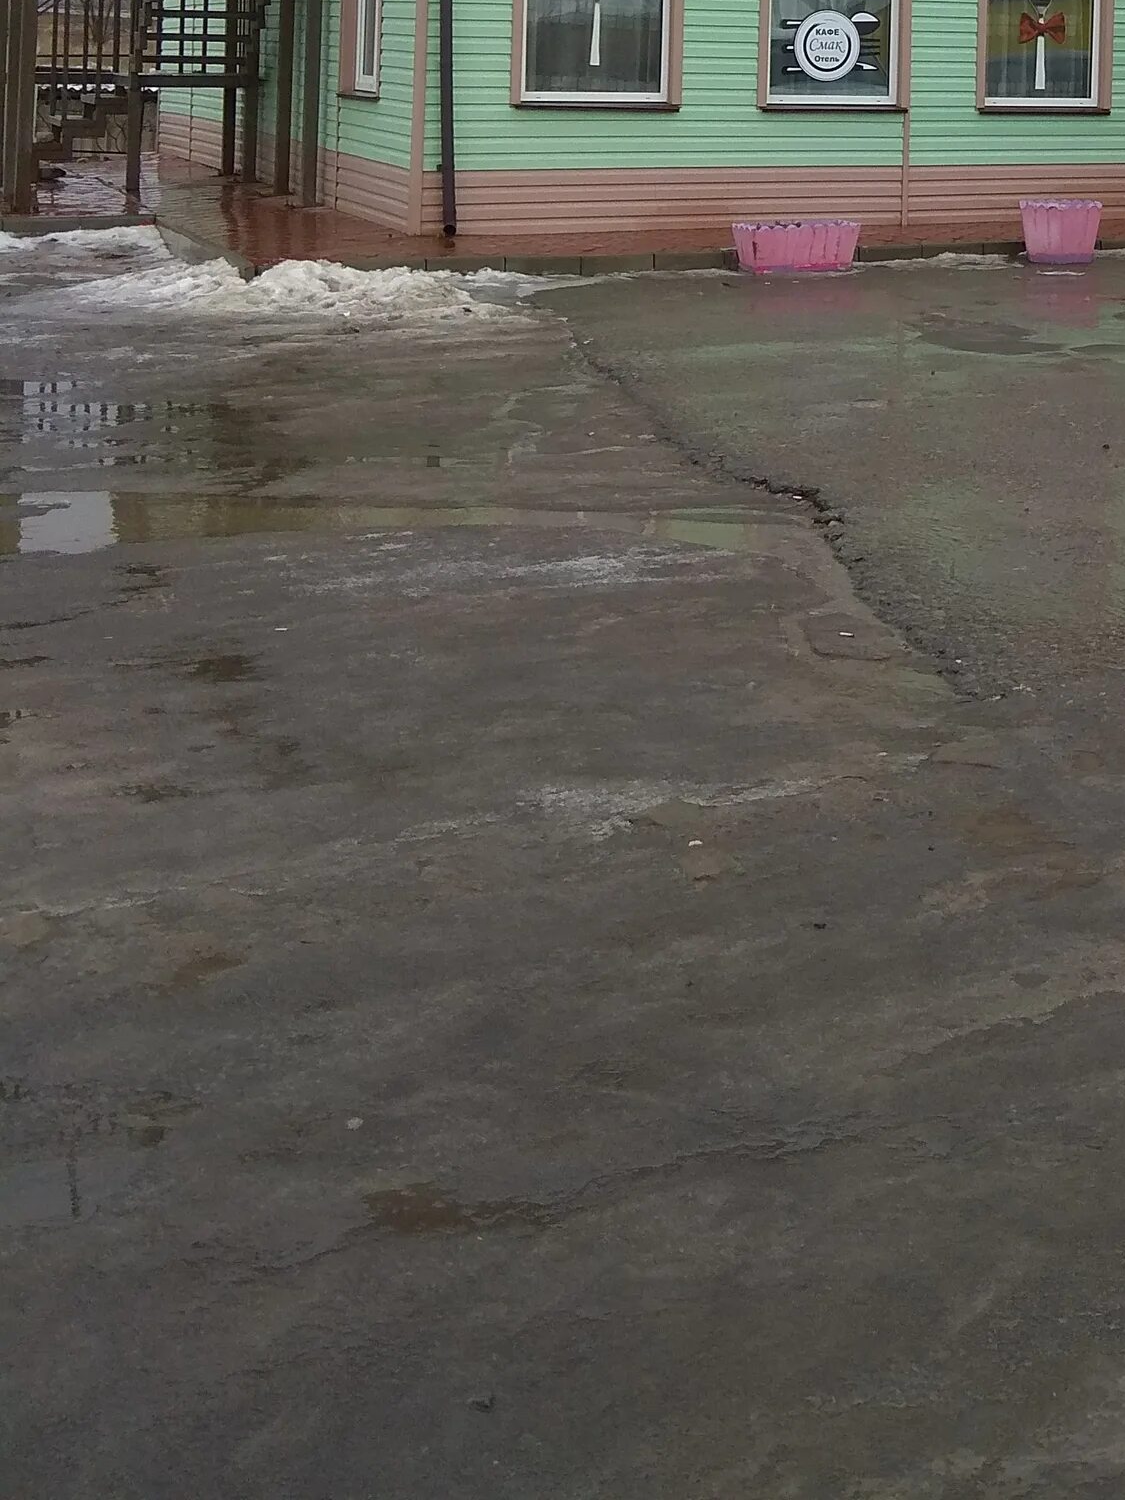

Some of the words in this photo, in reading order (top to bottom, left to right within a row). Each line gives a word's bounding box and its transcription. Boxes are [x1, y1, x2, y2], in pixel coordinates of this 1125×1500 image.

[815, 28, 840, 36] КАФЕ
[810, 38, 846, 53] Смак
[814, 55, 840, 63] Отель
